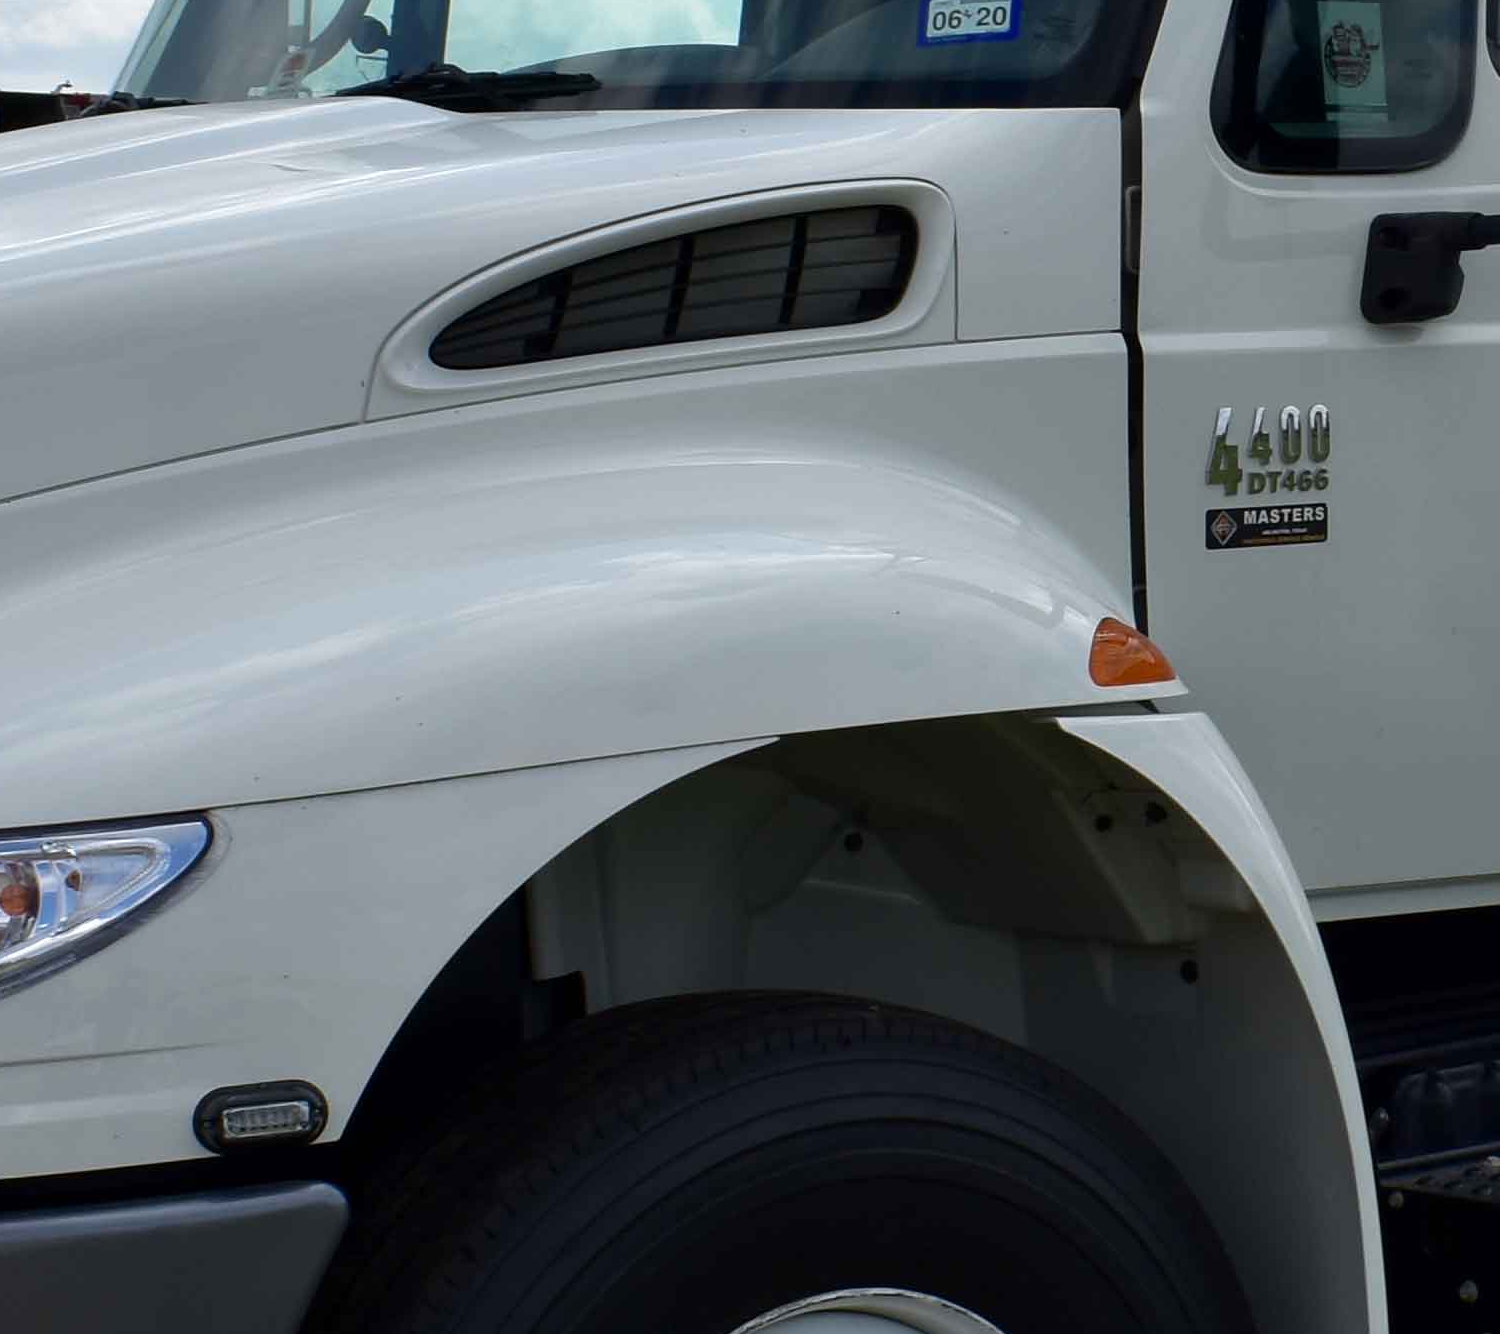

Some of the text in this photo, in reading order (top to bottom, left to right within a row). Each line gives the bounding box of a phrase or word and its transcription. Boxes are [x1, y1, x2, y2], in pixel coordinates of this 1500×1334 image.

[932, 6, 1007, 31] 06 20
[1205, 404, 1330, 496] 4400
[1247, 468, 1329, 495] DT466
[1243, 506, 1325, 525] MASTERS
